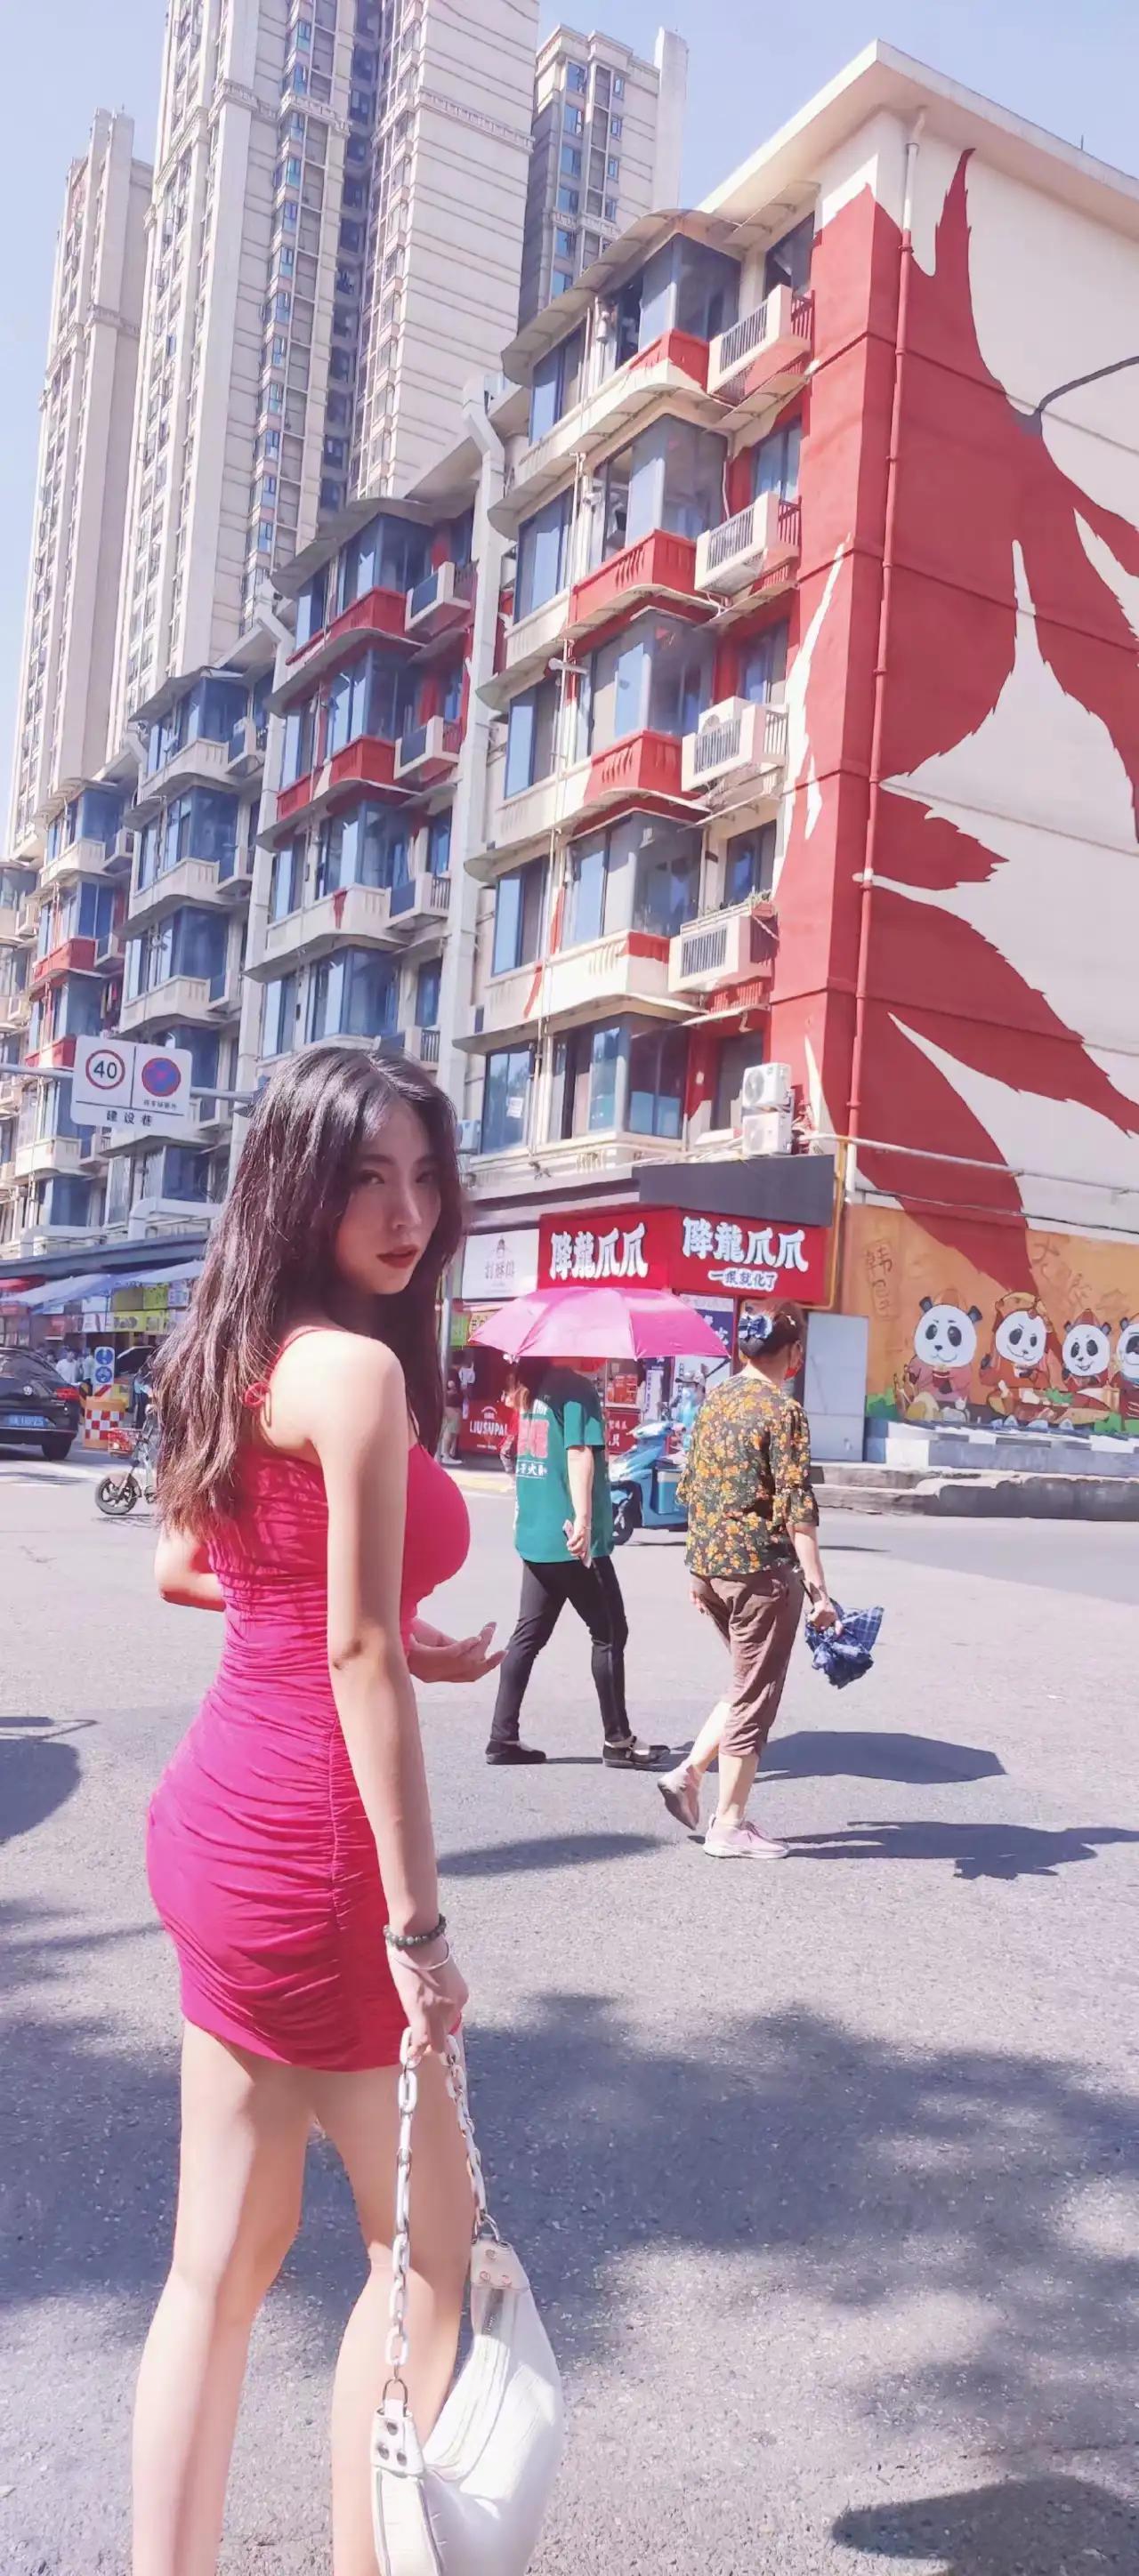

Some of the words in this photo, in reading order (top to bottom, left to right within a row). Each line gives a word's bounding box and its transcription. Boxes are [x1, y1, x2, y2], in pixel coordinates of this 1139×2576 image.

[93, 1060, 117, 1079] 40
[106, 1110, 152, 1126] 建设巷
